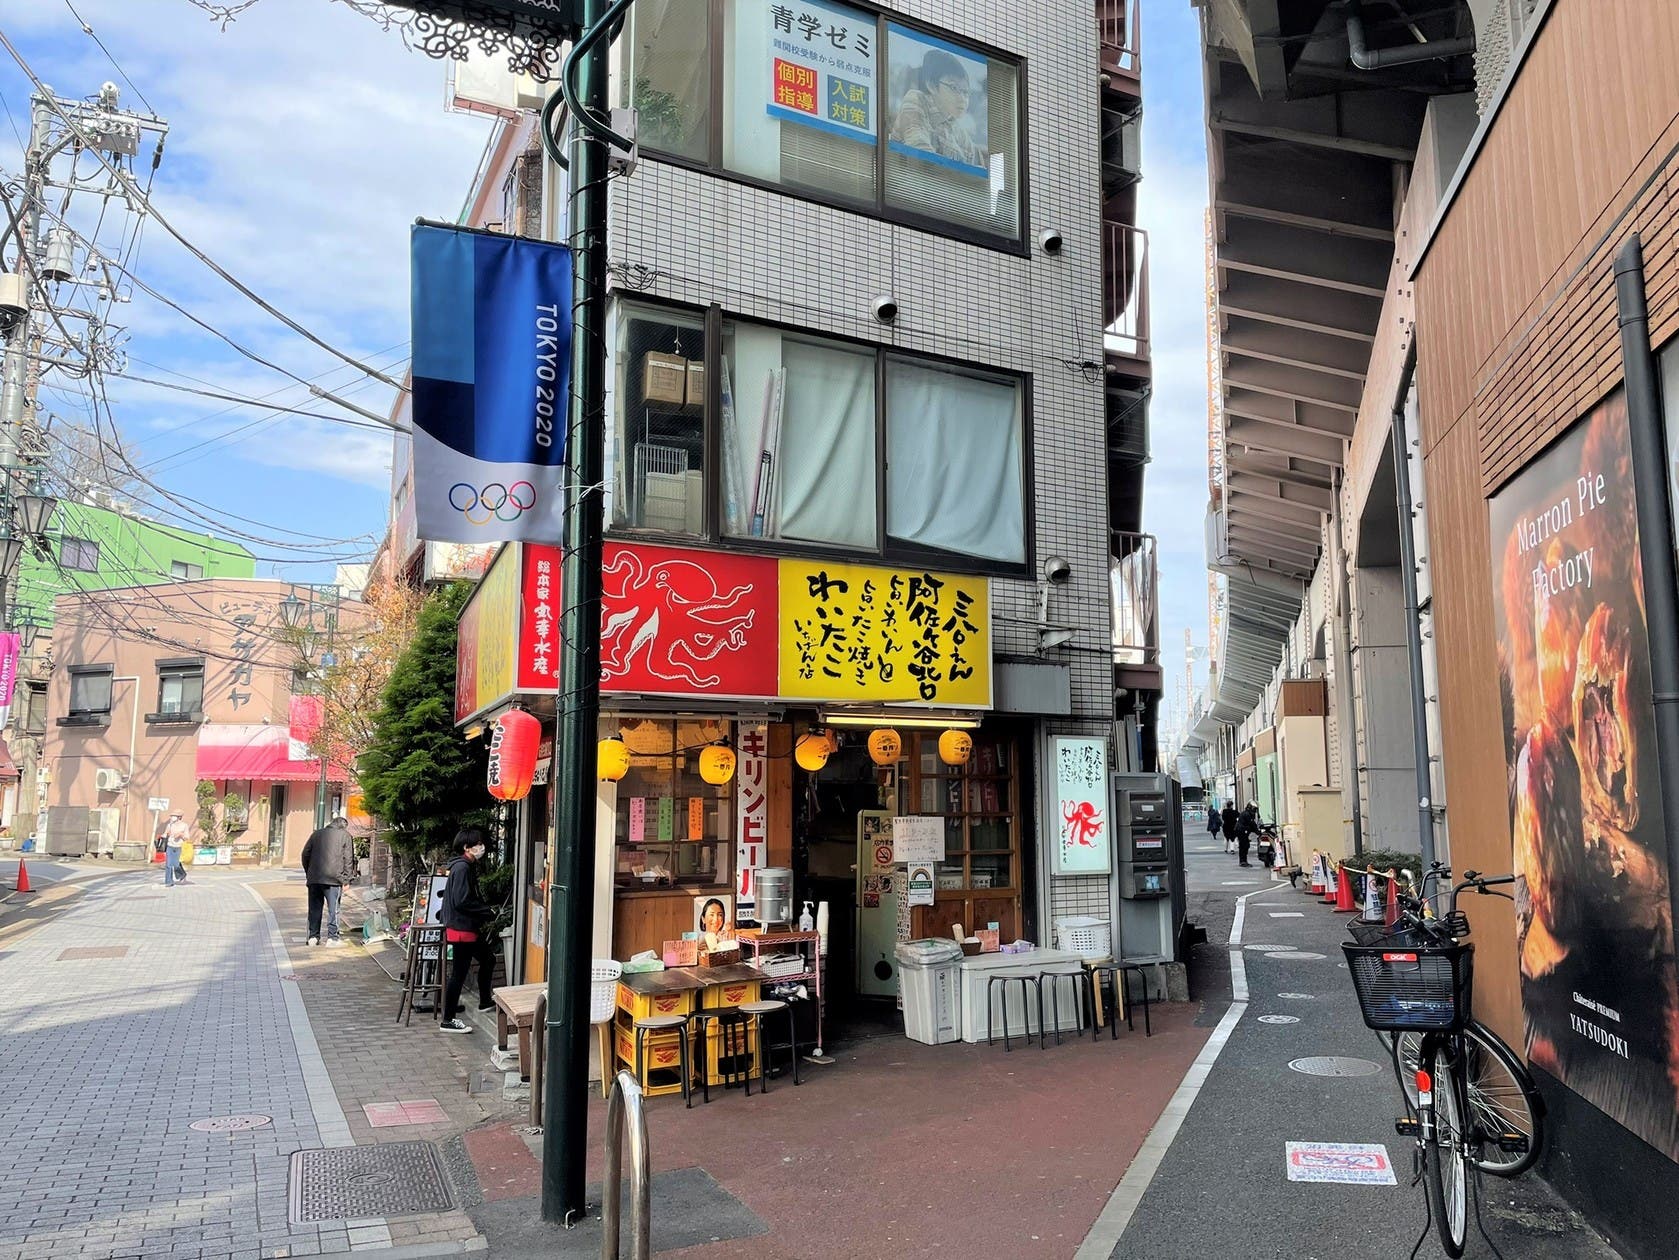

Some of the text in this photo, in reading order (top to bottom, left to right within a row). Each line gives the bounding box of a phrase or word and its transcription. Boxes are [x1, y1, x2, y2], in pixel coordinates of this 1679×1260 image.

[770, 4, 871, 58] 青学ゼミ
[778, 62, 814, 89] 個別
[778, 85, 814, 111] 指導
[832, 80, 866, 104] 入試
[832, 102, 866, 127] 対策
[536, 304, 558, 448] TOKYO 2020
[1516, 471, 1606, 556] Marron Pie
[1532, 547, 1594, 601] Factory
[806, 571, 849, 678] わいたこ
[741, 731, 765, 897] キリンビール
[1569, 1013, 1629, 1059] YATSUDOKI
